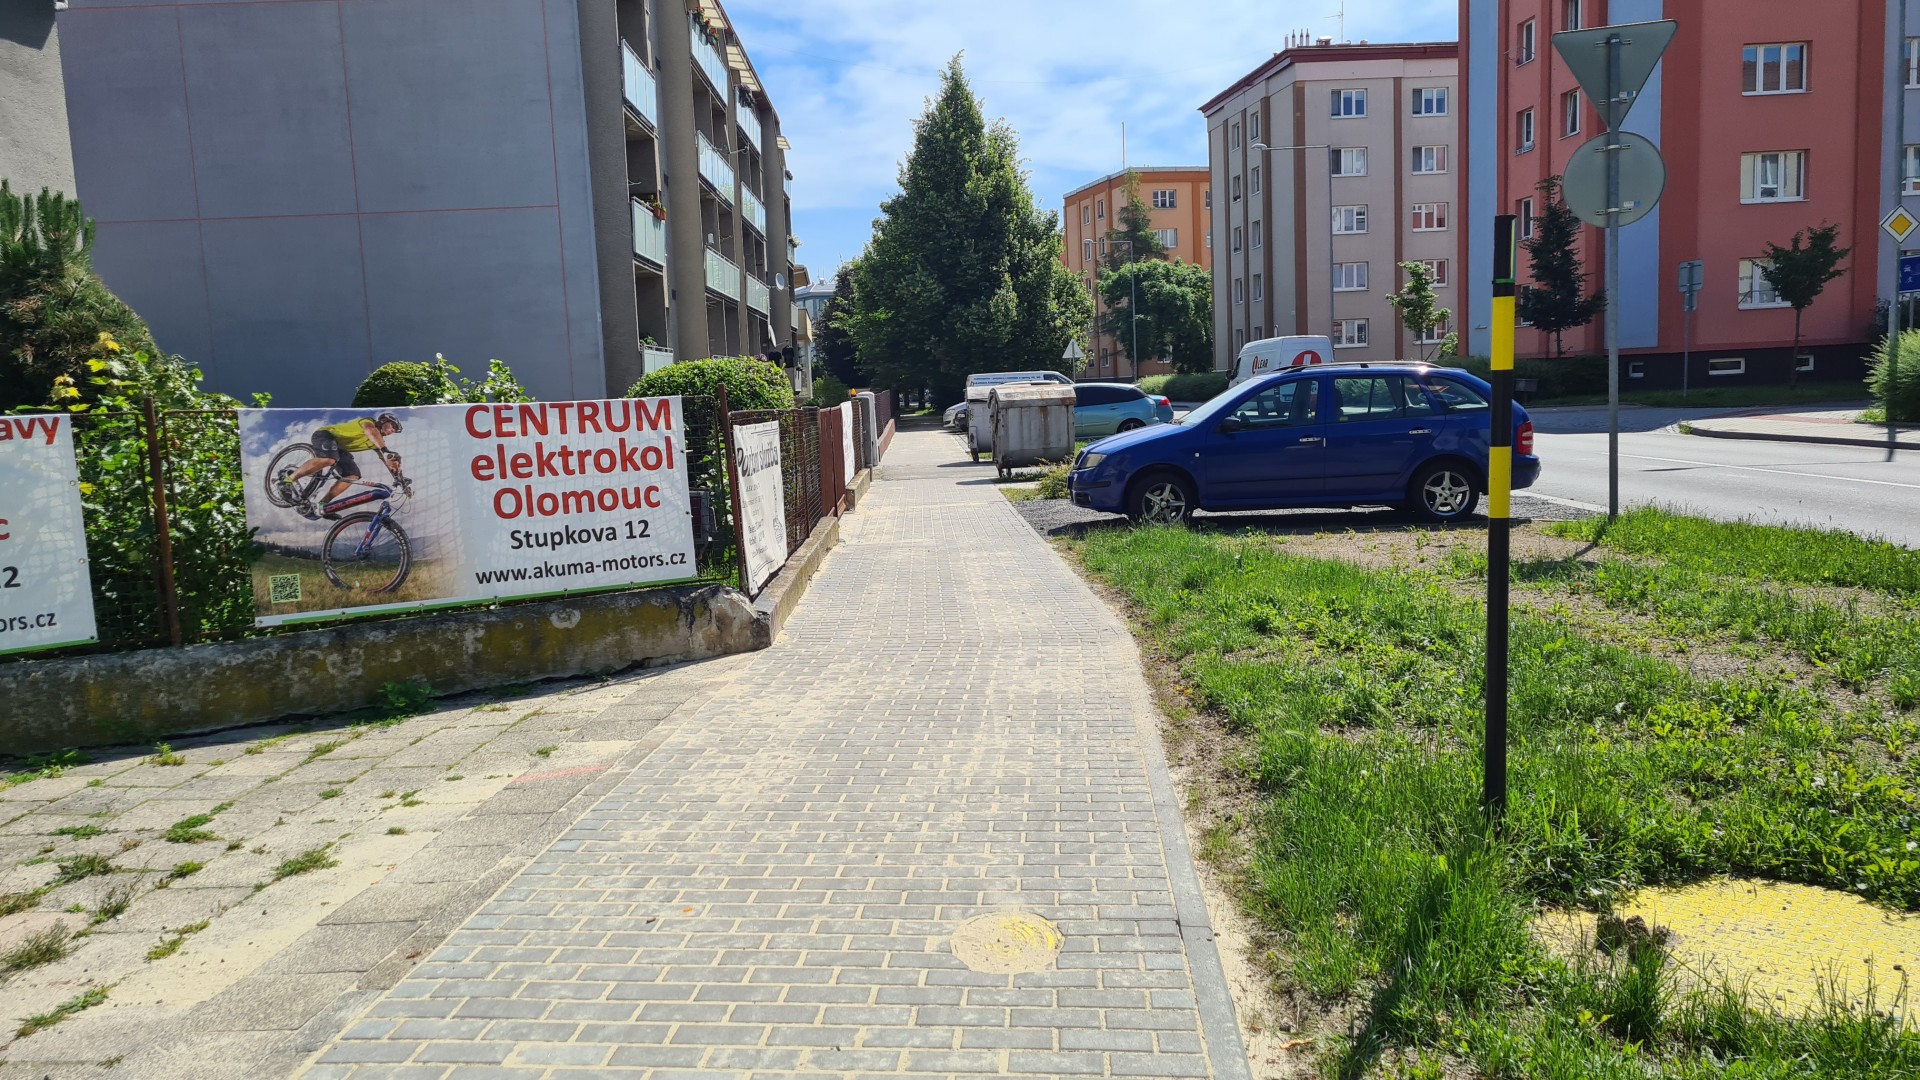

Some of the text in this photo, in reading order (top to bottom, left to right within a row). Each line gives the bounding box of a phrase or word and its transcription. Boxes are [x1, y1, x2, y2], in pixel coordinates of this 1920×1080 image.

[465, 399, 672, 439] CENTRUM
[470, 436, 675, 482] elektrokol
[493, 484, 661, 520] Olomouc
[510, 520, 651, 550] Stupkova 12
[0, 565, 21, 589] 2
[476, 553, 687, 585] www.akuma-motors.cz
